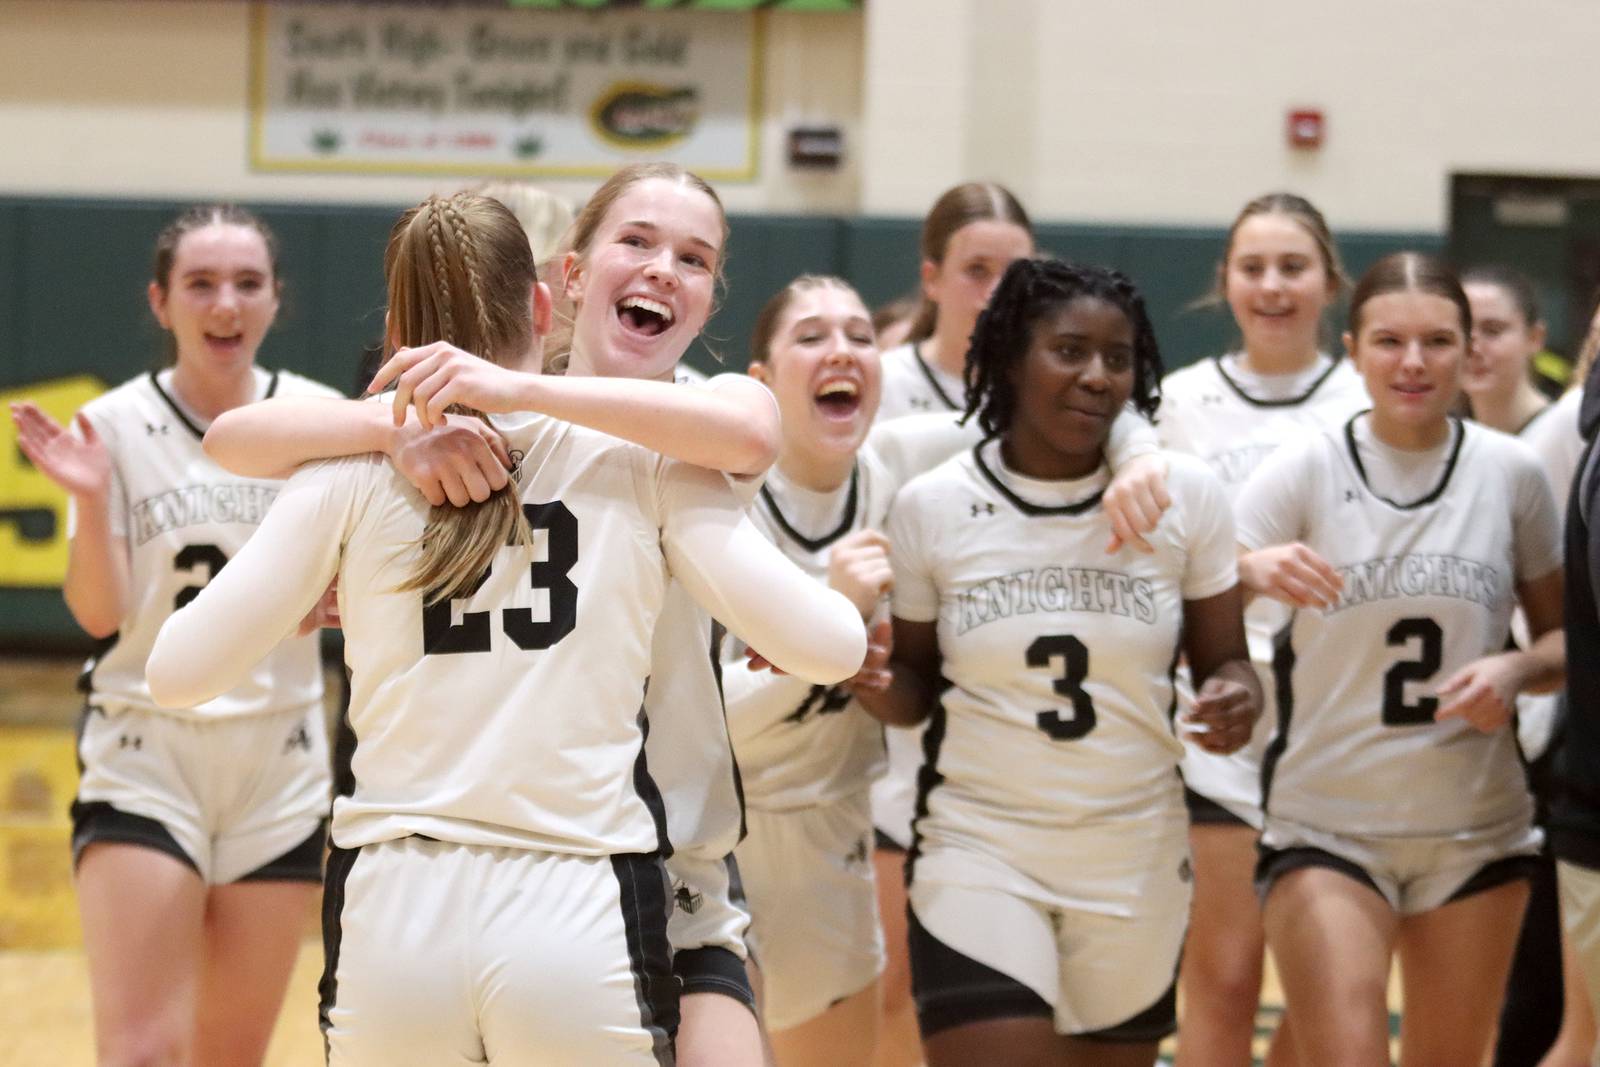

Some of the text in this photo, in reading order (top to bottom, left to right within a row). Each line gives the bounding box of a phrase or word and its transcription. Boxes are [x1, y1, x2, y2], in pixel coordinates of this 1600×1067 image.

[131, 483, 281, 547] KNIGH
[421, 500, 578, 656] 23
[956, 566, 1157, 637] KNIGHTS
[1025, 634, 1097, 741] 3
[1381, 617, 1443, 727] 2
